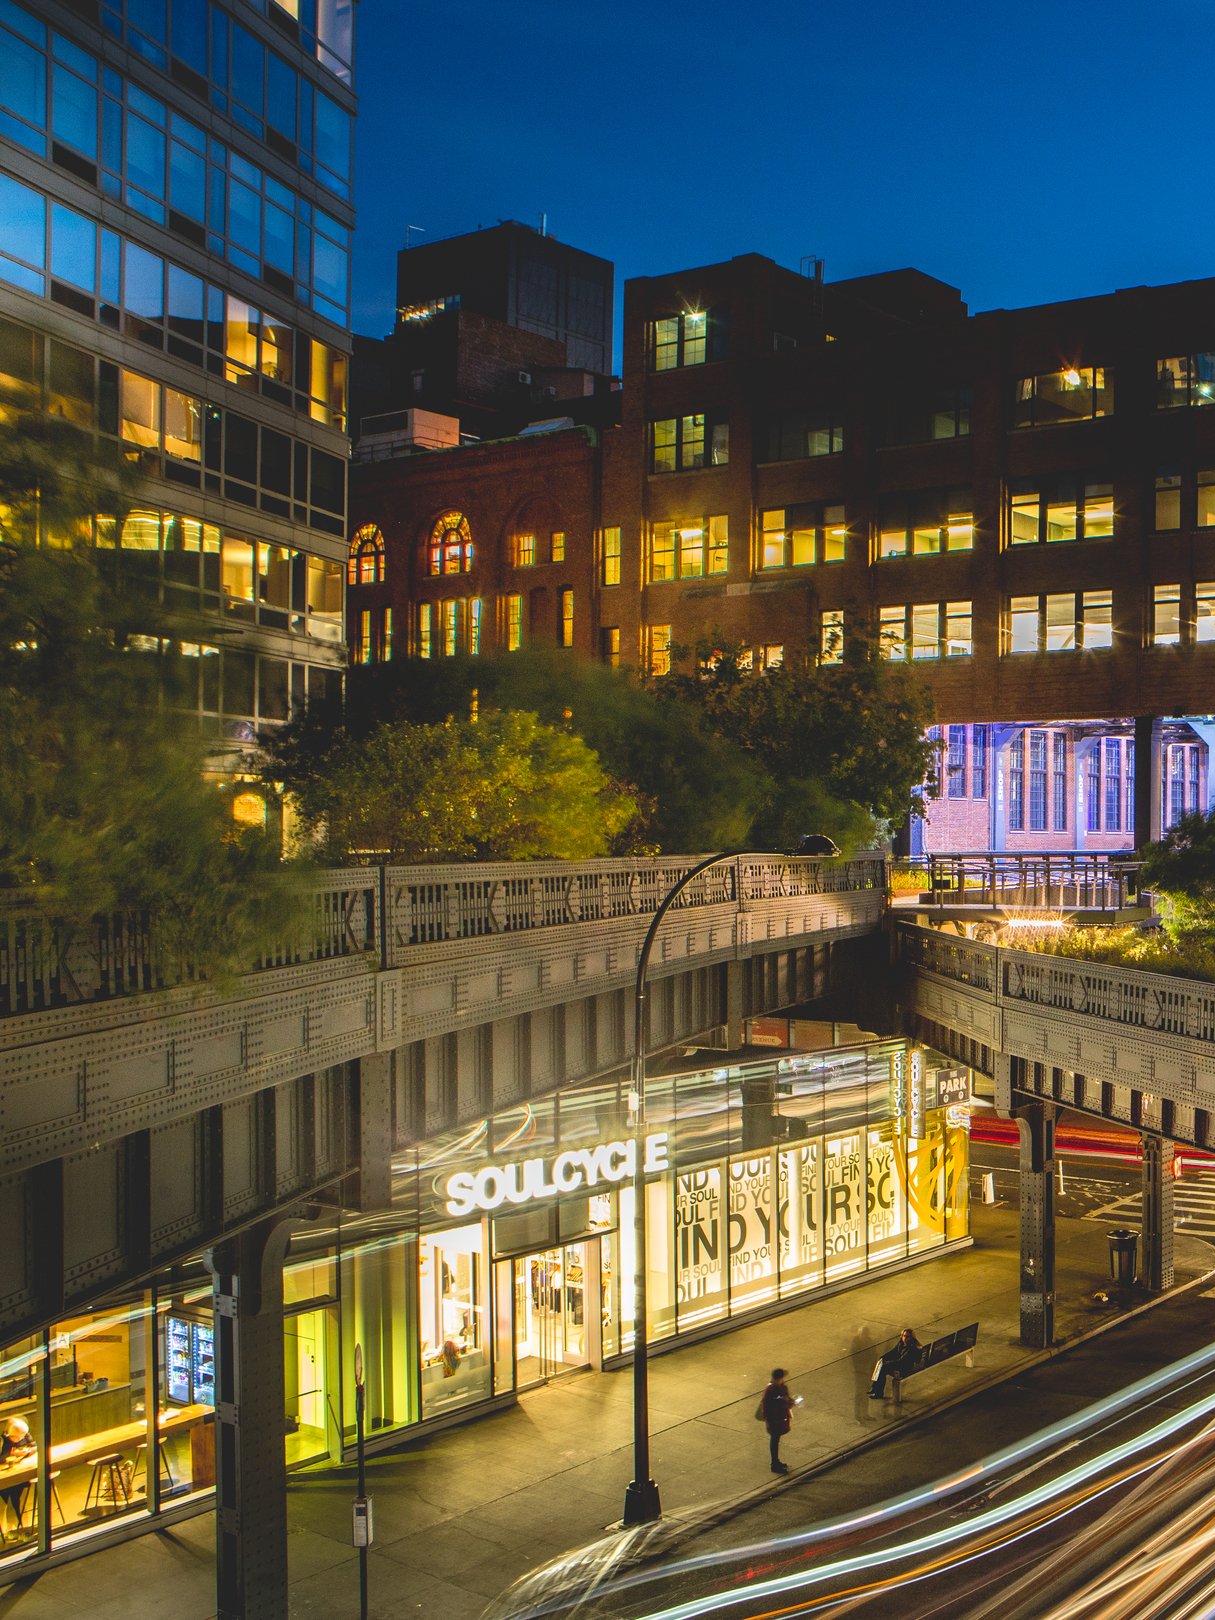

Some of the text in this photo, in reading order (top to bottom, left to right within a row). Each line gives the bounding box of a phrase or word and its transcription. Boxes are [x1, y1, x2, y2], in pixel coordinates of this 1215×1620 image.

[940, 1076, 967, 1095] PARK
[446, 1133, 669, 1216] SOULCYCLE
[690, 1187, 718, 1204] SOUL
